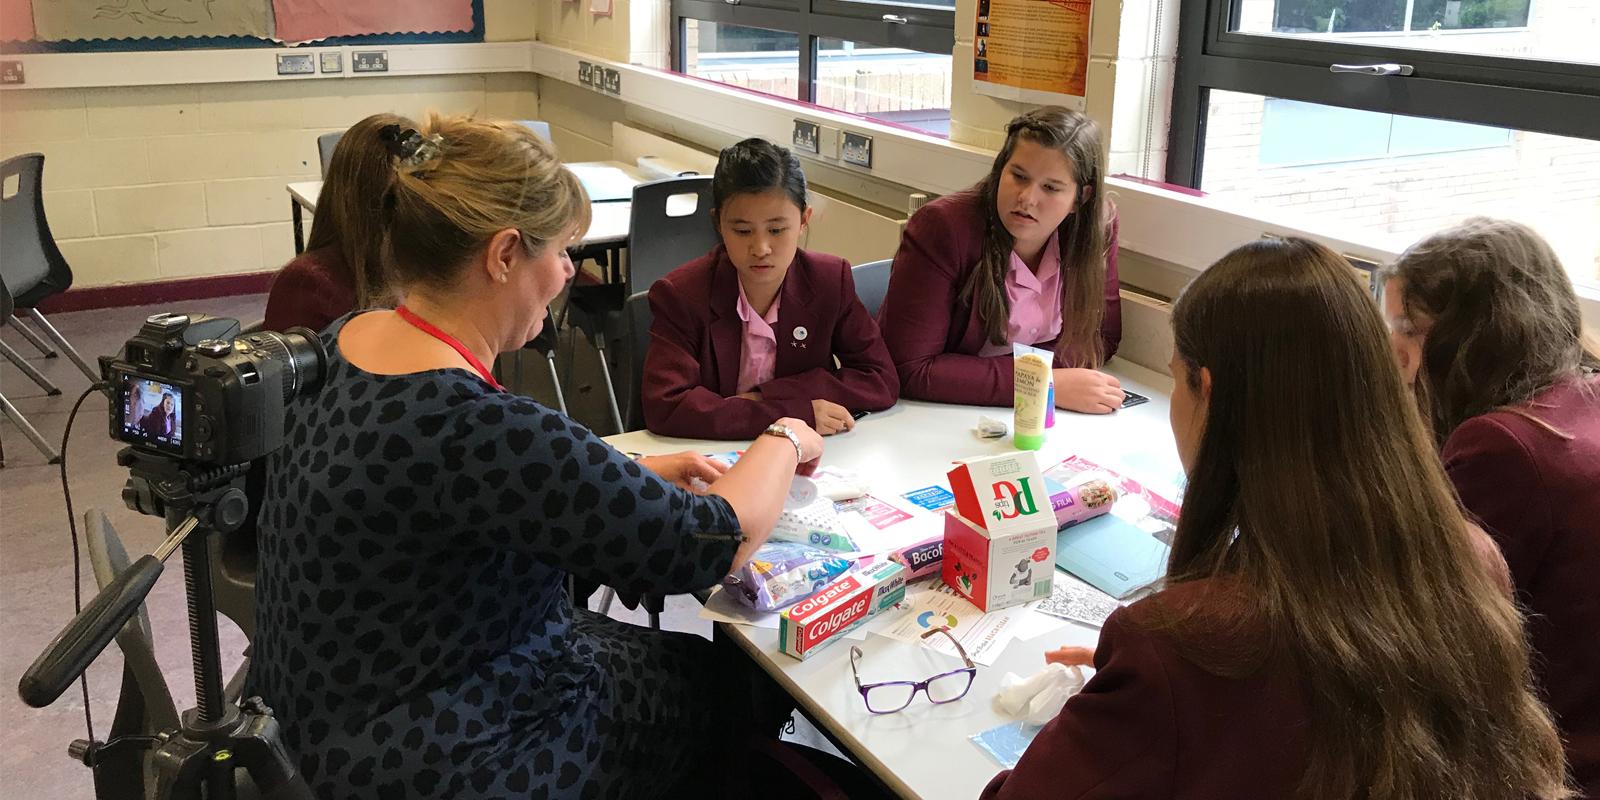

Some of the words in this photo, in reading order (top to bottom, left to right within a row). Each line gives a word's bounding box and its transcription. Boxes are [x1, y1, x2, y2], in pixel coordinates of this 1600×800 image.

[991, 477, 1040, 519] PG
[791, 579, 851, 616] Colgate
[808, 598, 866, 640] Colgate
